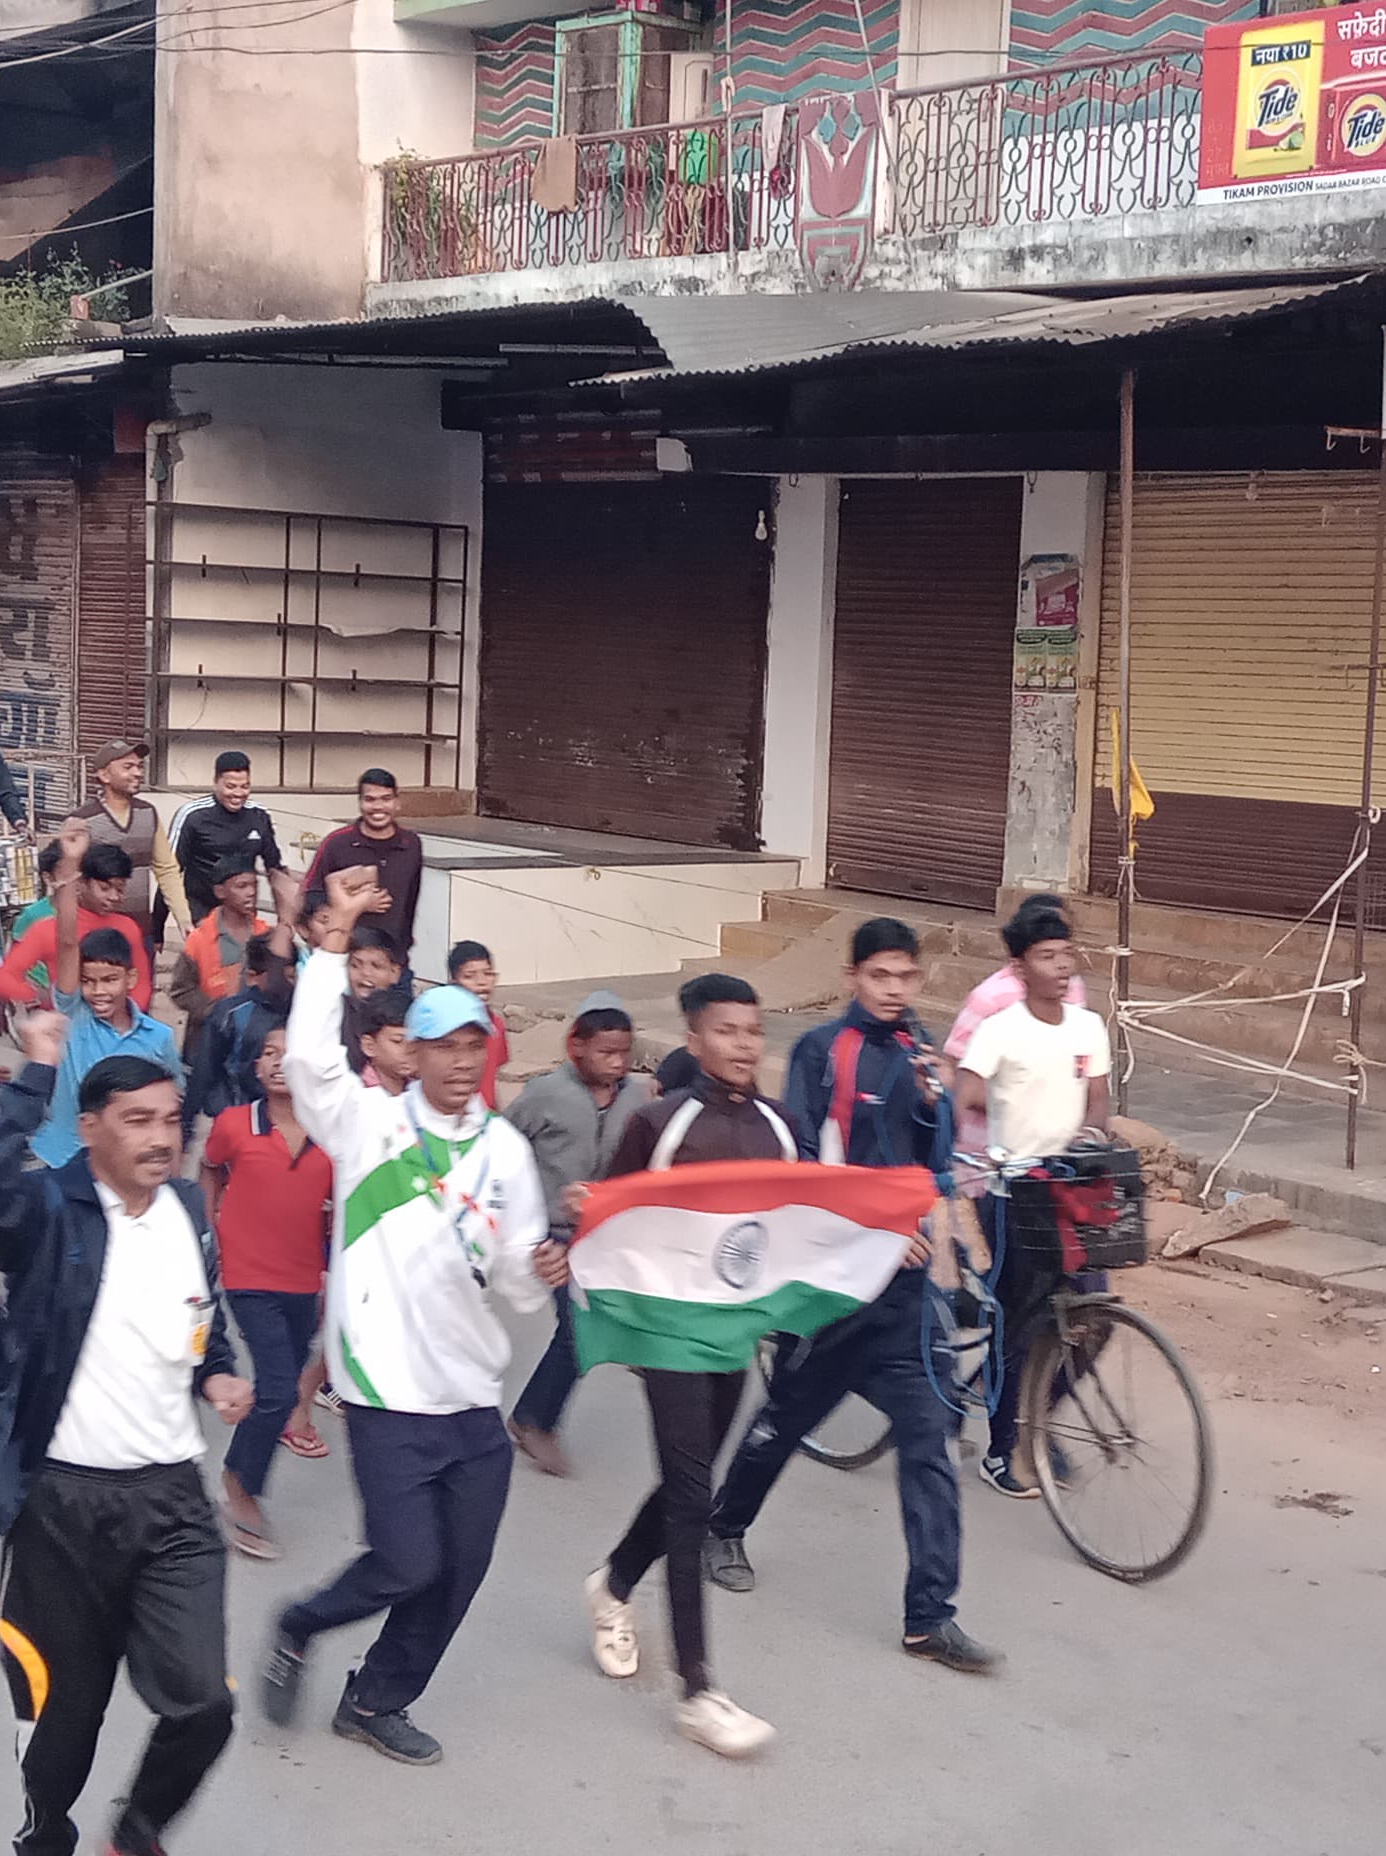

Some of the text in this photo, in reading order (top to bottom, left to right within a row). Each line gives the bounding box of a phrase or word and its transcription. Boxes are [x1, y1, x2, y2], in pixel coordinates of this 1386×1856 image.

[1254, 47, 1280, 65] नया
[1258, 87, 1299, 128] Tide
[1348, 109, 1386, 149] Tide
[1223, 186, 1255, 201] TIKAM
[1257, 179, 1313, 198] PROVISION
